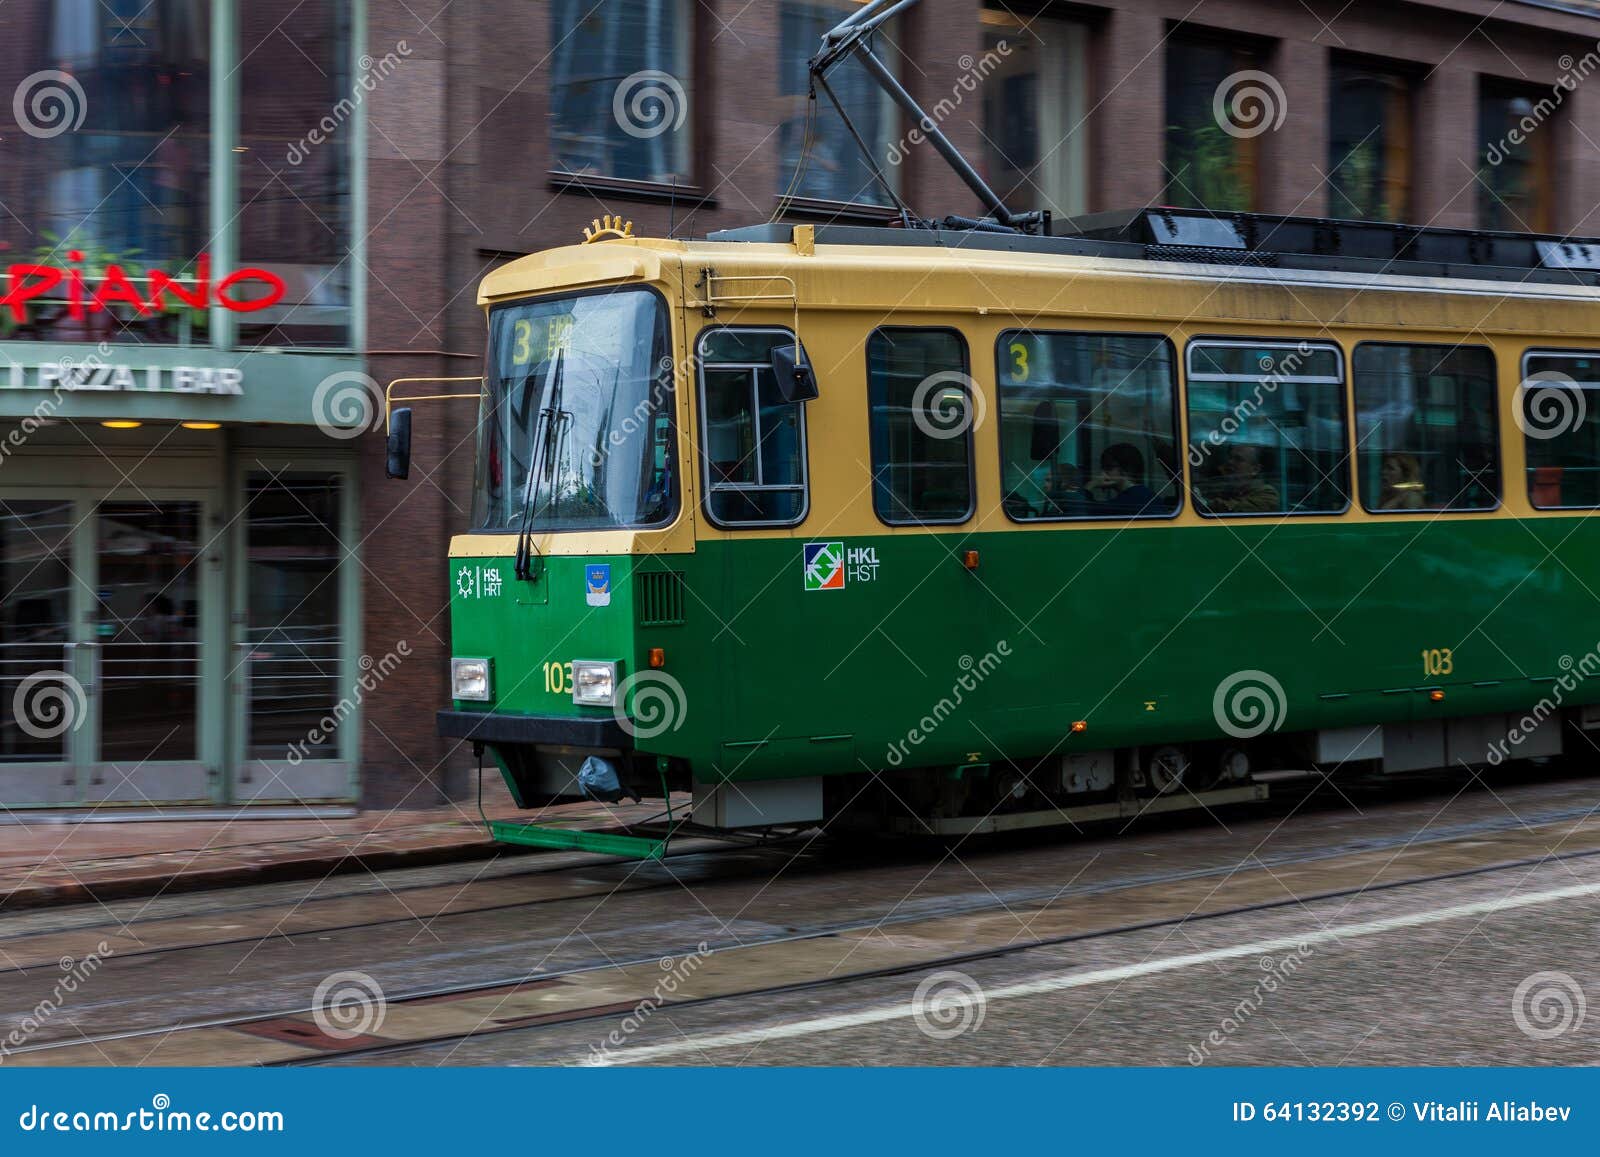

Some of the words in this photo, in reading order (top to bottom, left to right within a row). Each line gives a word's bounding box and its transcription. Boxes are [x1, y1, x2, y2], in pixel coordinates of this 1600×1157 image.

[513, 319, 531, 365] 3
[1010, 343, 1029, 383] 3
[172, 366, 243, 395] BAR
[848, 547, 880, 564] HKL
[483, 568, 502, 582] HSL
[848, 565, 880, 582] HST
[484, 583, 502, 597] HRT
[1422, 648, 1453, 675] 103
[543, 661, 573, 694] 103
